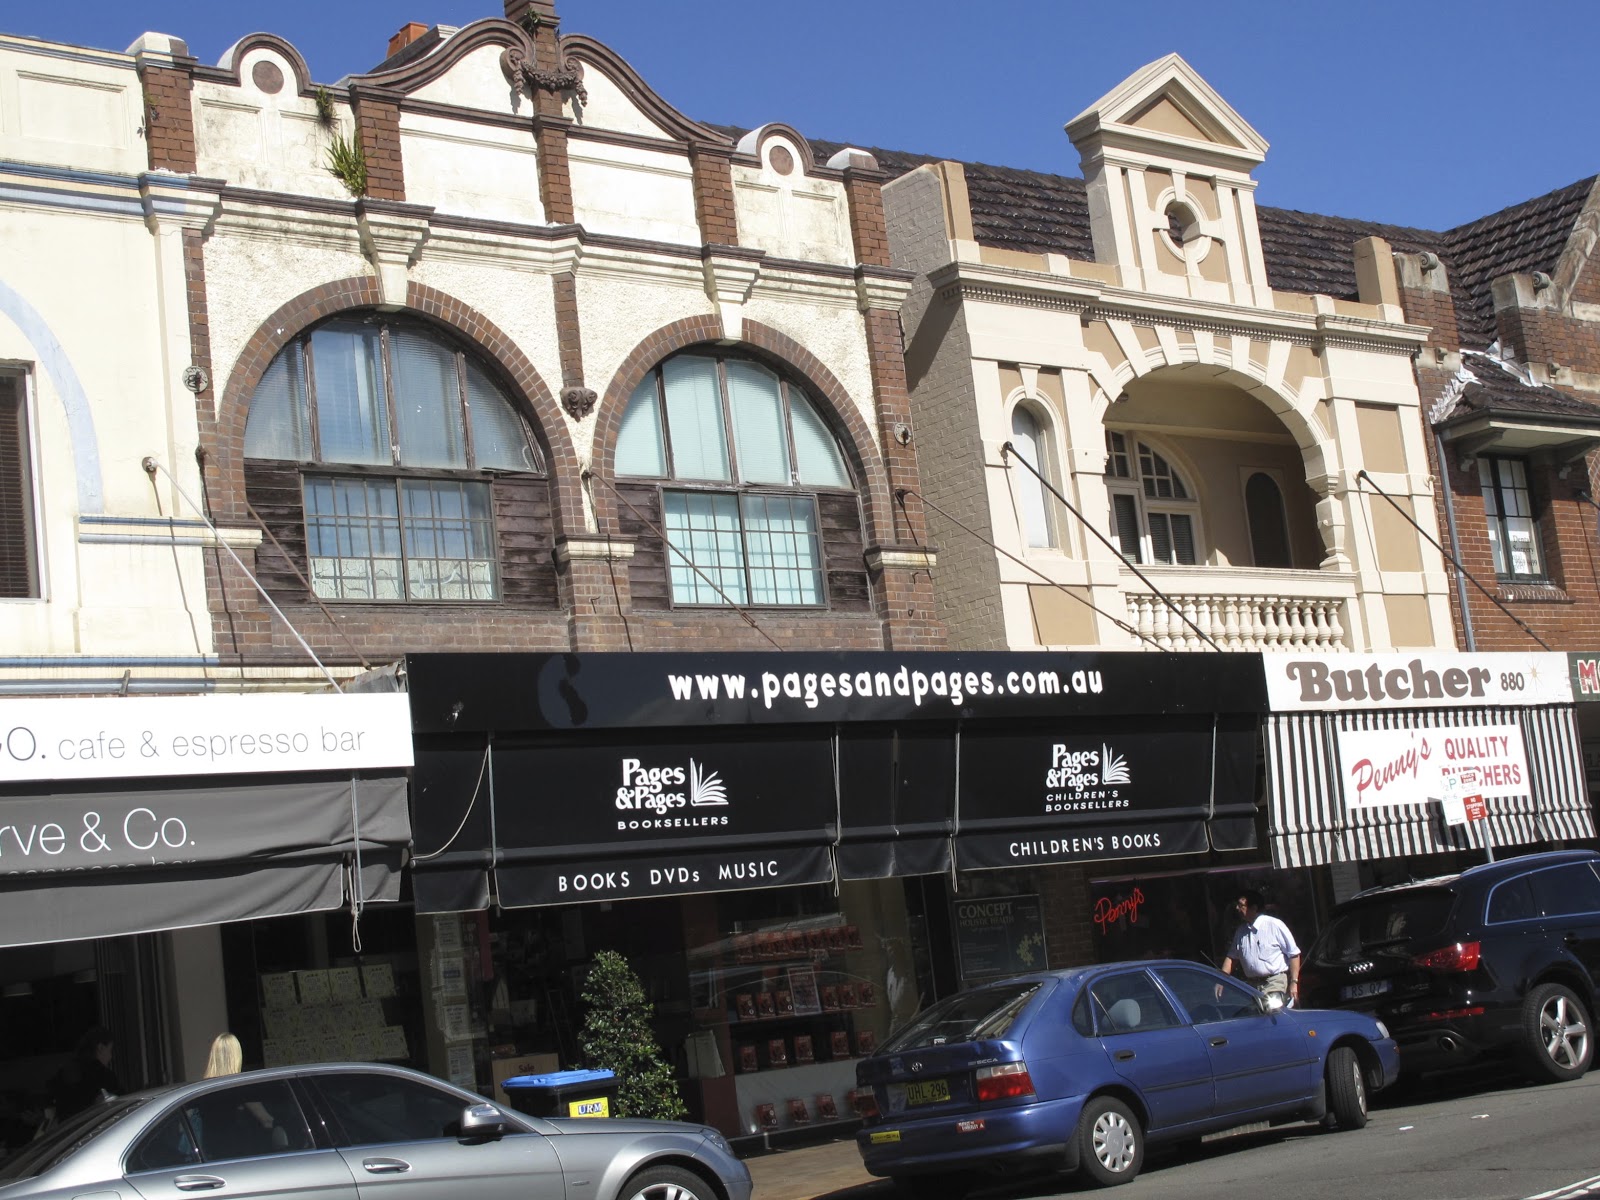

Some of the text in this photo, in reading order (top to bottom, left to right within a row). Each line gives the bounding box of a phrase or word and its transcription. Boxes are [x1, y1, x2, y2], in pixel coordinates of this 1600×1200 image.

[668, 664, 1104, 710] www.pagesandpages.com.au
[1286, 659, 1526, 702] Butcher 880
[58, 731, 126, 760] cafe
[140, 730, 160, 758] &
[172, 733, 309, 762] espresso
[321, 726, 366, 752] bar
[1052, 743, 1099, 769] Pages
[1445, 736, 1509, 760] QUALITY
[622, 758, 686, 792] Pages
[1351, 732, 1432, 804] Penny's
[1045, 799, 1130, 813] BOOKSELLERS
[1046, 790, 1119, 802] CHILDREN'S
[80, 811, 112, 853] &
[123, 807, 196, 850] Co.
[617, 816, 729, 830] BOOKSELLERS
[1009, 833, 1161, 857] CHILDREN'S BOOKS
[558, 860, 778, 892] BOOKS DVDs MUSIC
[959, 902, 1012, 919] CONCEPT
[1094, 887, 1146, 935] Penny's
